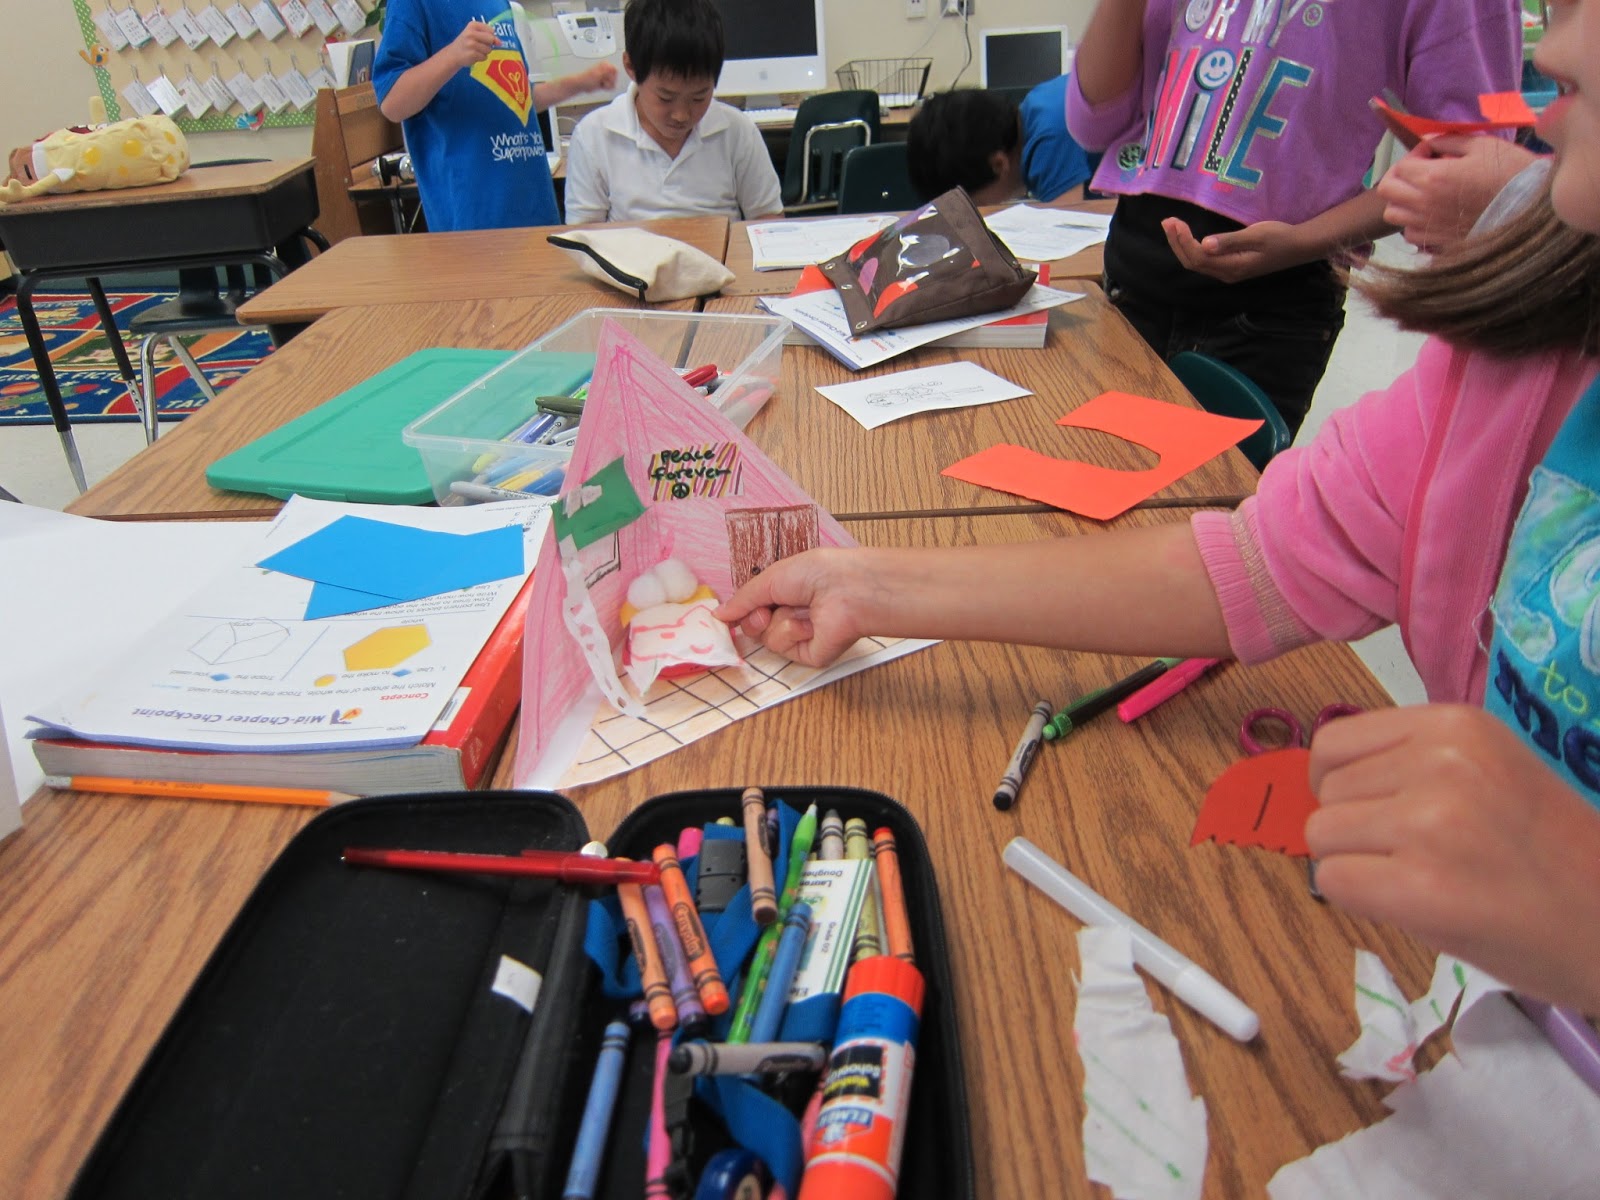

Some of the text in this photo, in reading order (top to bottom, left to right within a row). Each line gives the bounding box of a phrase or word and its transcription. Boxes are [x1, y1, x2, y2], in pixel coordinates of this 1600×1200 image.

[1139, 46, 1314, 190] MILE
[492, 145, 545, 163] Superpowe
[651, 467, 732, 482] forever
[1537, 658, 1589, 716] to
[379, 692, 429, 701] Concepts
[131, 708, 326, 726] Mid-Chapter Checkpoint
[675, 903, 703, 957] Crayola
